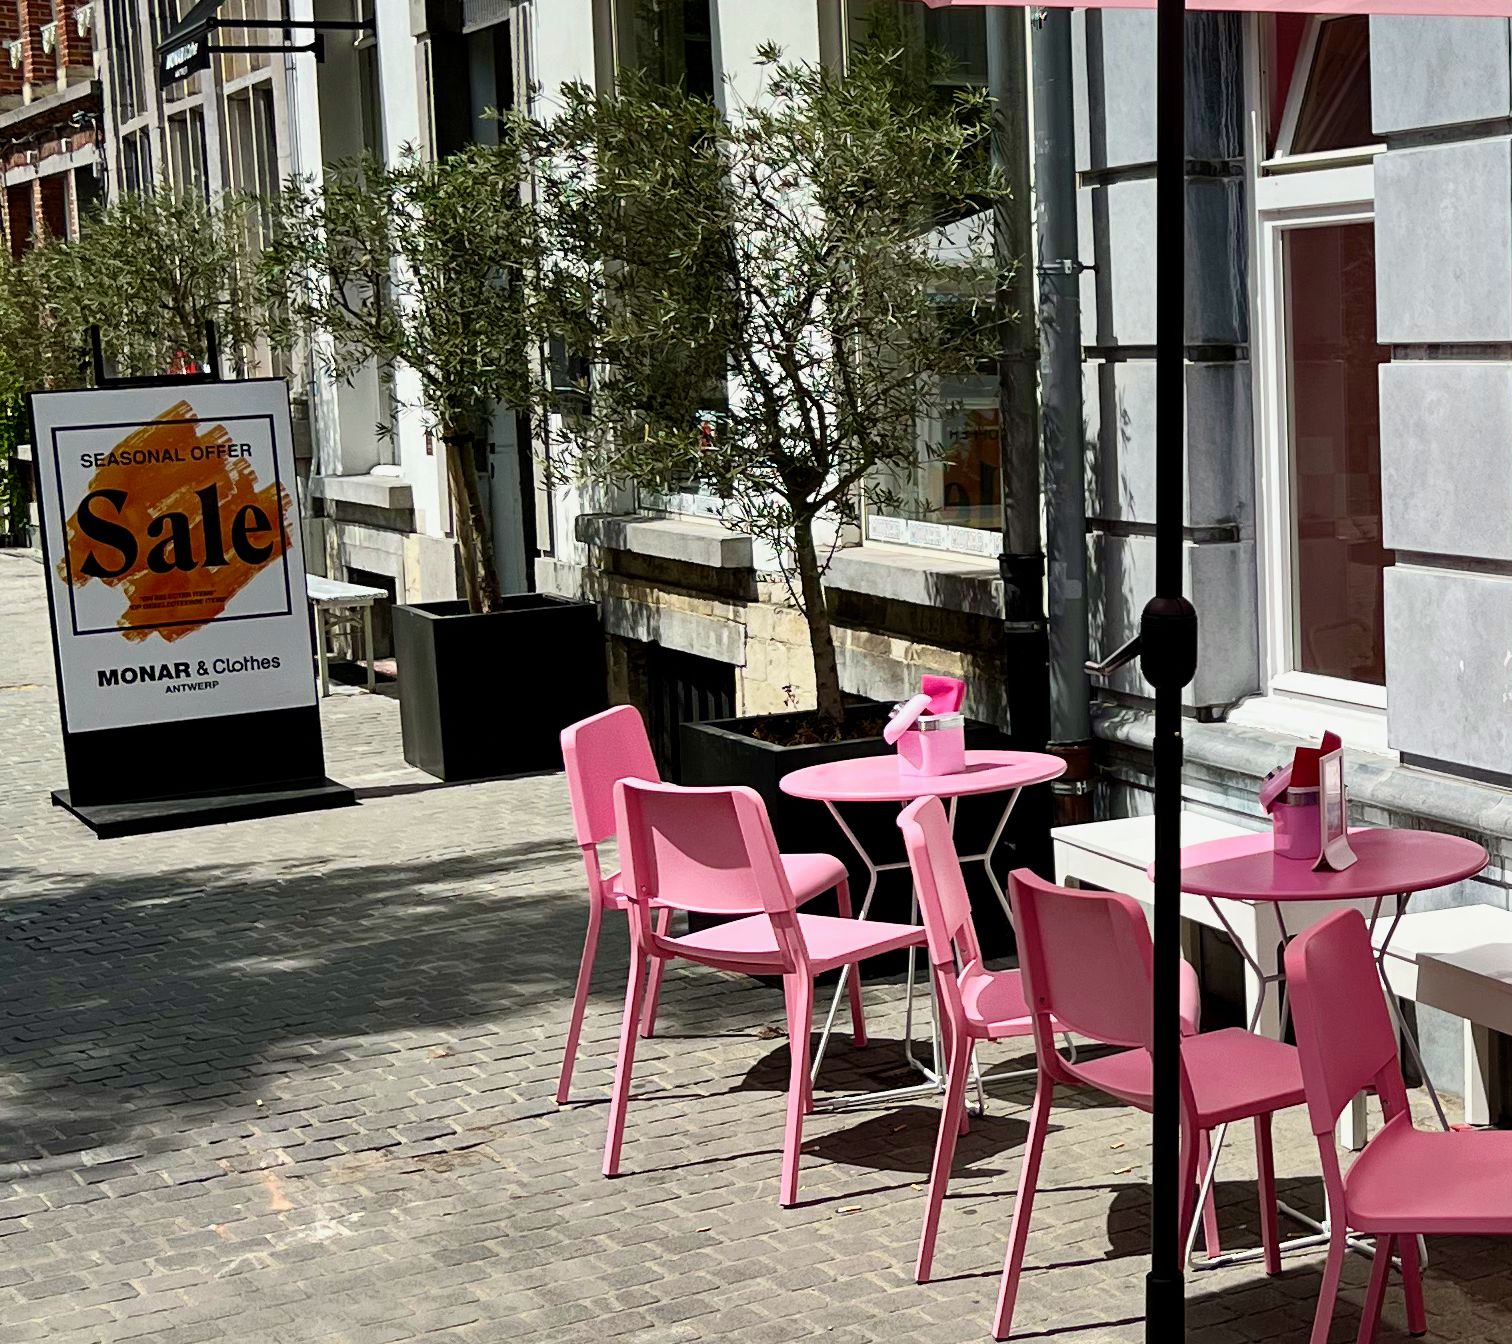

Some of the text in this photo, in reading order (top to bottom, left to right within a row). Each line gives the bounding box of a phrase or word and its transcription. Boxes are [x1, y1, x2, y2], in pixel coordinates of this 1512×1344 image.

[80, 443, 252, 469] SEASONAL OFFER
[76, 482, 275, 580] Sale
[97, 654, 281, 688] MONAR & Clothes
[165, 679, 220, 694] ANTWERP
